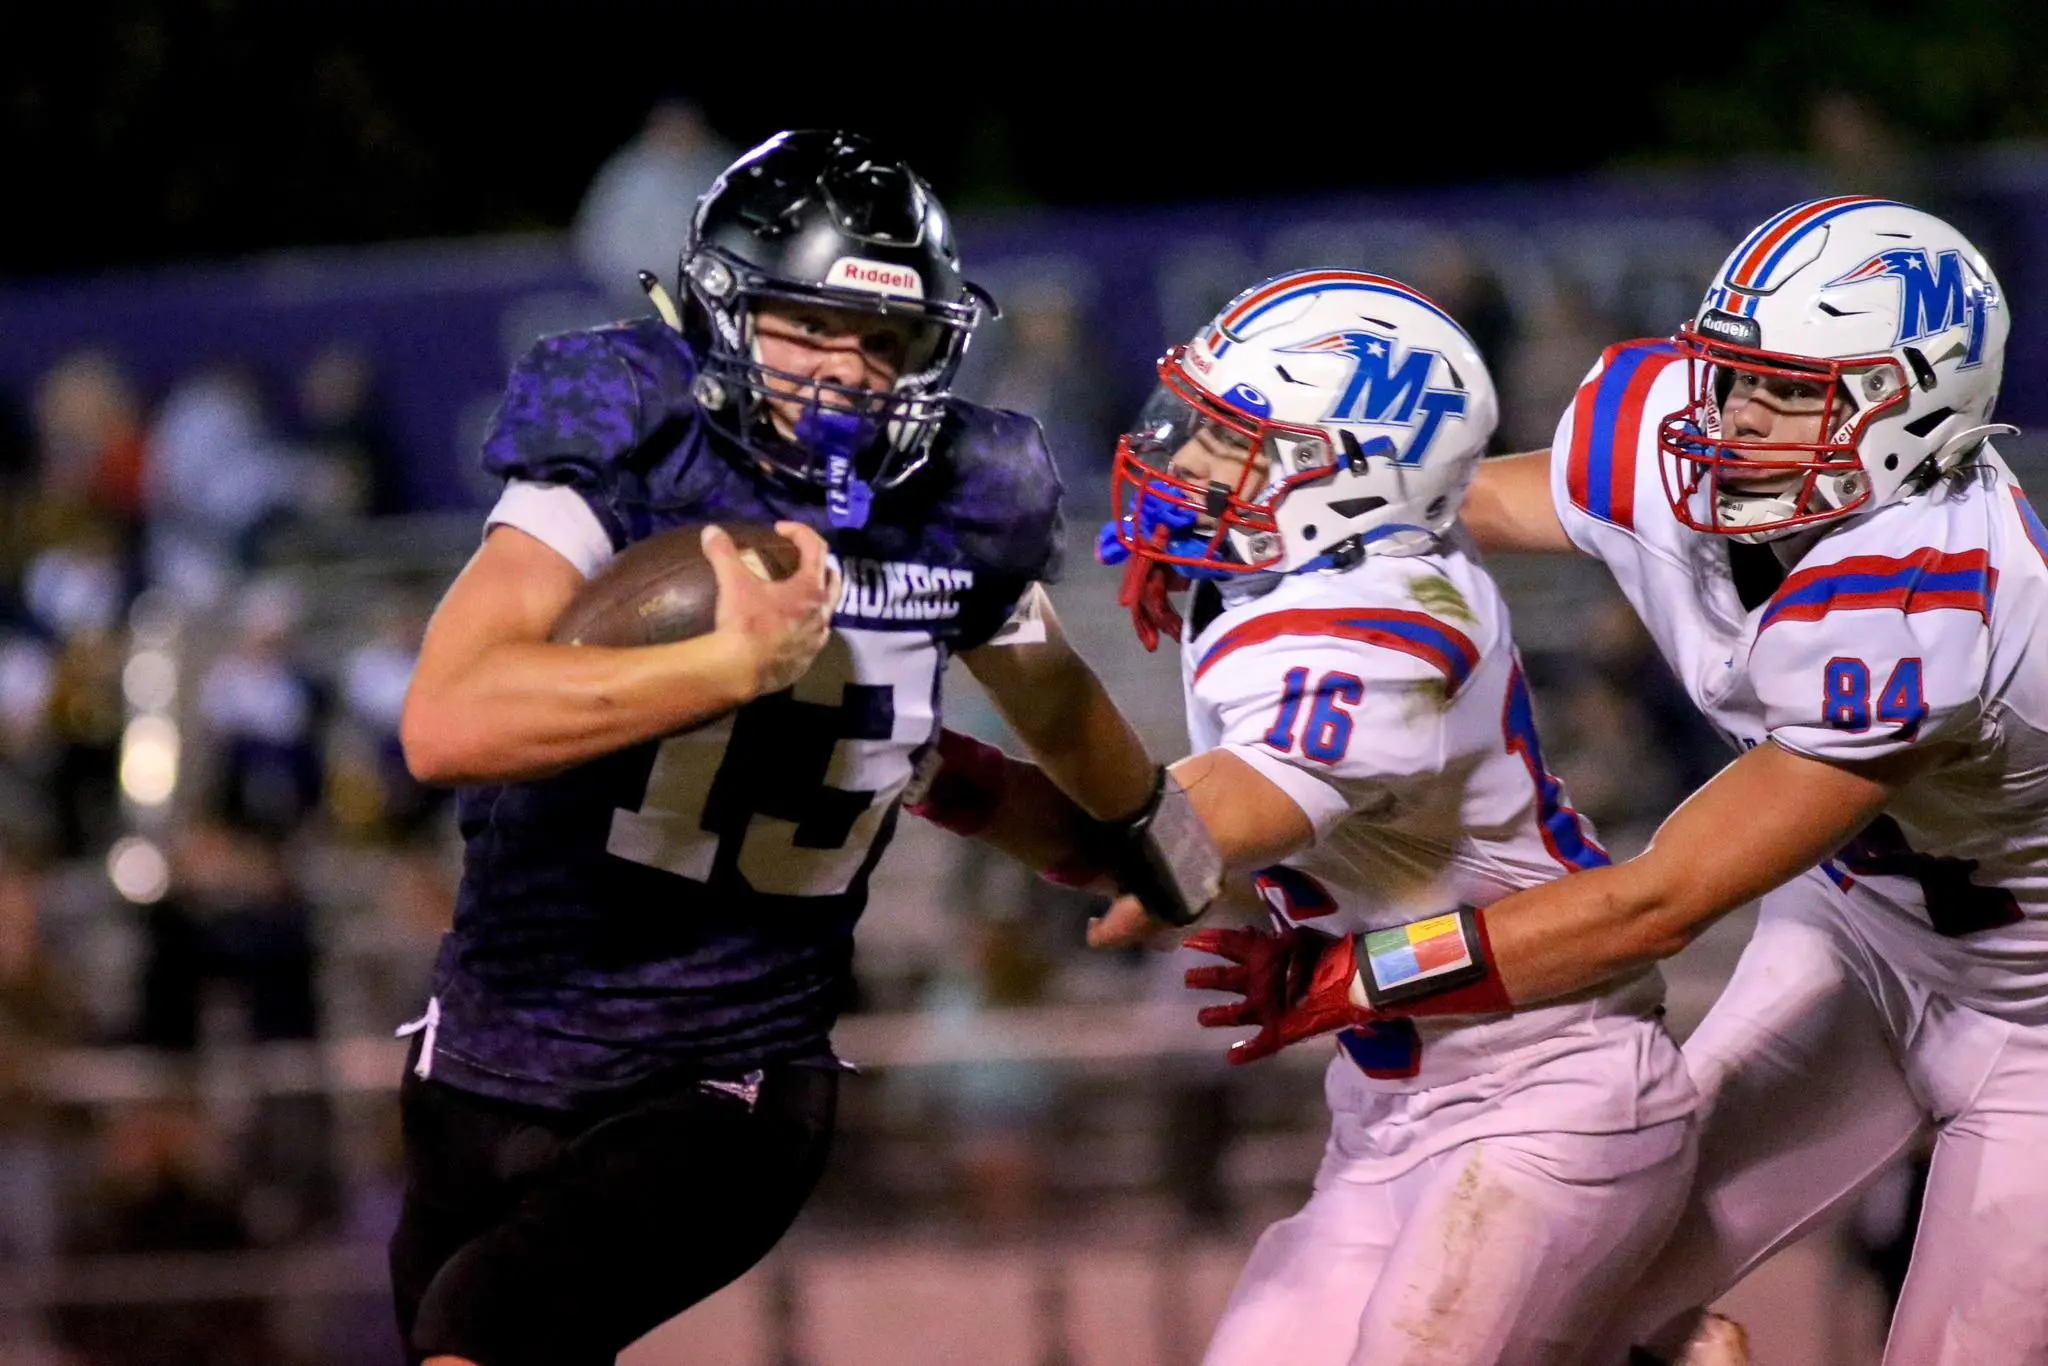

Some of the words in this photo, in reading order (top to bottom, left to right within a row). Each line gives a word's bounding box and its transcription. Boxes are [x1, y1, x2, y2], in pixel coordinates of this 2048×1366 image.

[844, 263, 915, 289] Riddell
[1312, 329, 1470, 468] MT
[1263, 666, 1364, 766] 16
[1823, 656, 1929, 742] 84
[605, 627, 937, 898] 13
